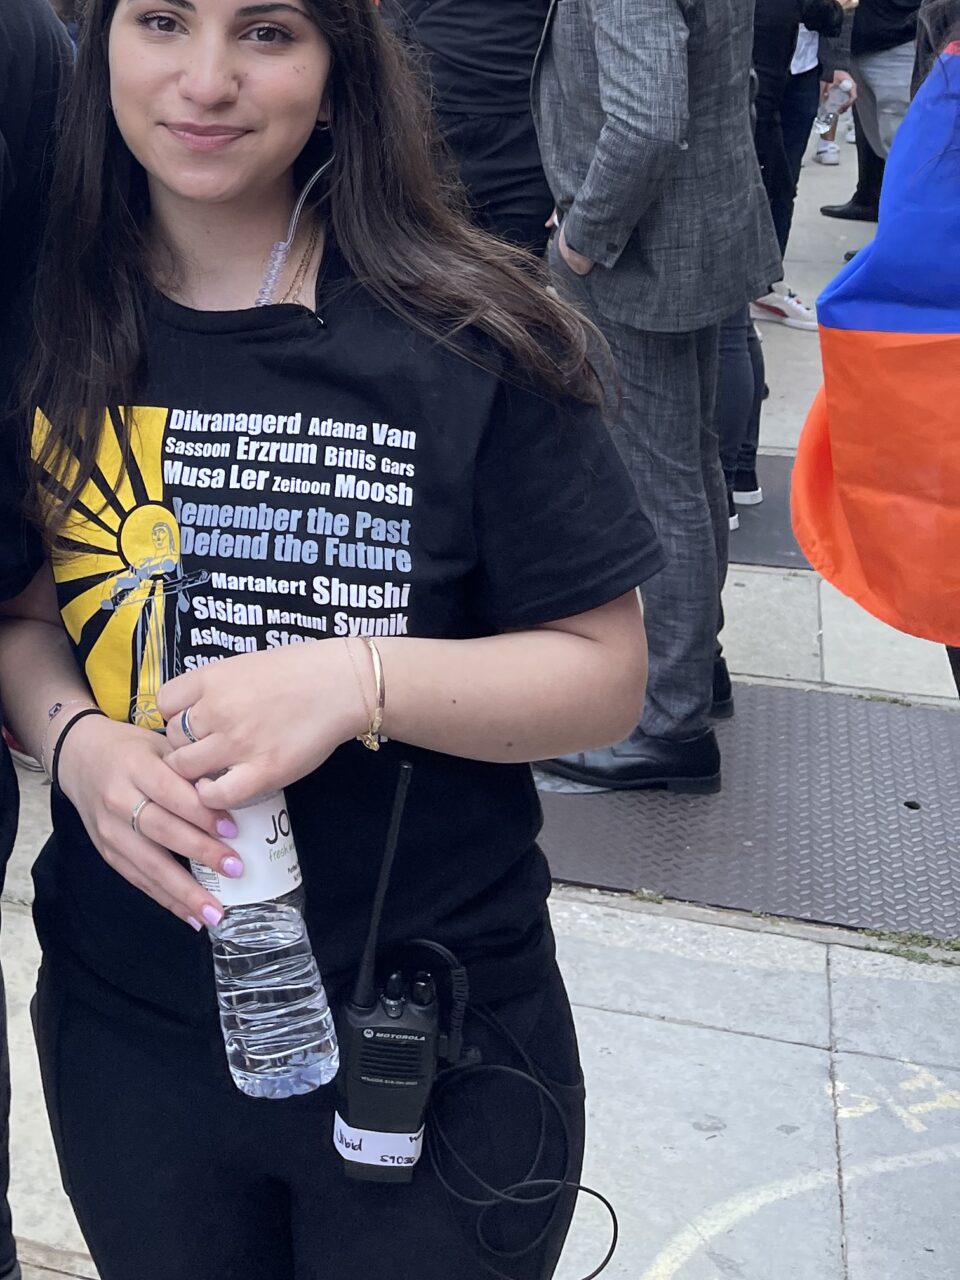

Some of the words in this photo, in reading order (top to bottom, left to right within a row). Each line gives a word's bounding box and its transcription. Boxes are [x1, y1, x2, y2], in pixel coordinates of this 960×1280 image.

[169, 408, 302, 436] Dikranagerd
[307, 417, 367, 441] Adana
[372, 422, 416, 450] Van
[165, 436, 230, 458] Sassoon
[237, 436, 318, 464] Erzrum
[324, 445, 376, 471] Bitlis
[381, 457, 415, 477] Gars
[163, 460, 225, 489] Musa
[229, 464, 270, 491] Ler
[272, 475, 331, 496] Zeitoon
[334, 474, 414, 507] Moosh
[307, 507, 349, 536] the
[355, 511, 411, 546] Past
[180, 527, 270, 560] Defend
[274, 534, 319, 564] the
[325, 537, 412, 572] Future
[211, 572, 307, 596] Martakert
[312, 575, 411, 609] Shushi
[192, 595, 263, 626] Sisian
[266, 609, 327, 632] Martuni
[334, 611, 408, 637] Syunik
[190, 627, 257, 653] Askeran
[376, 1032, 426, 1041] MOTOROLA
